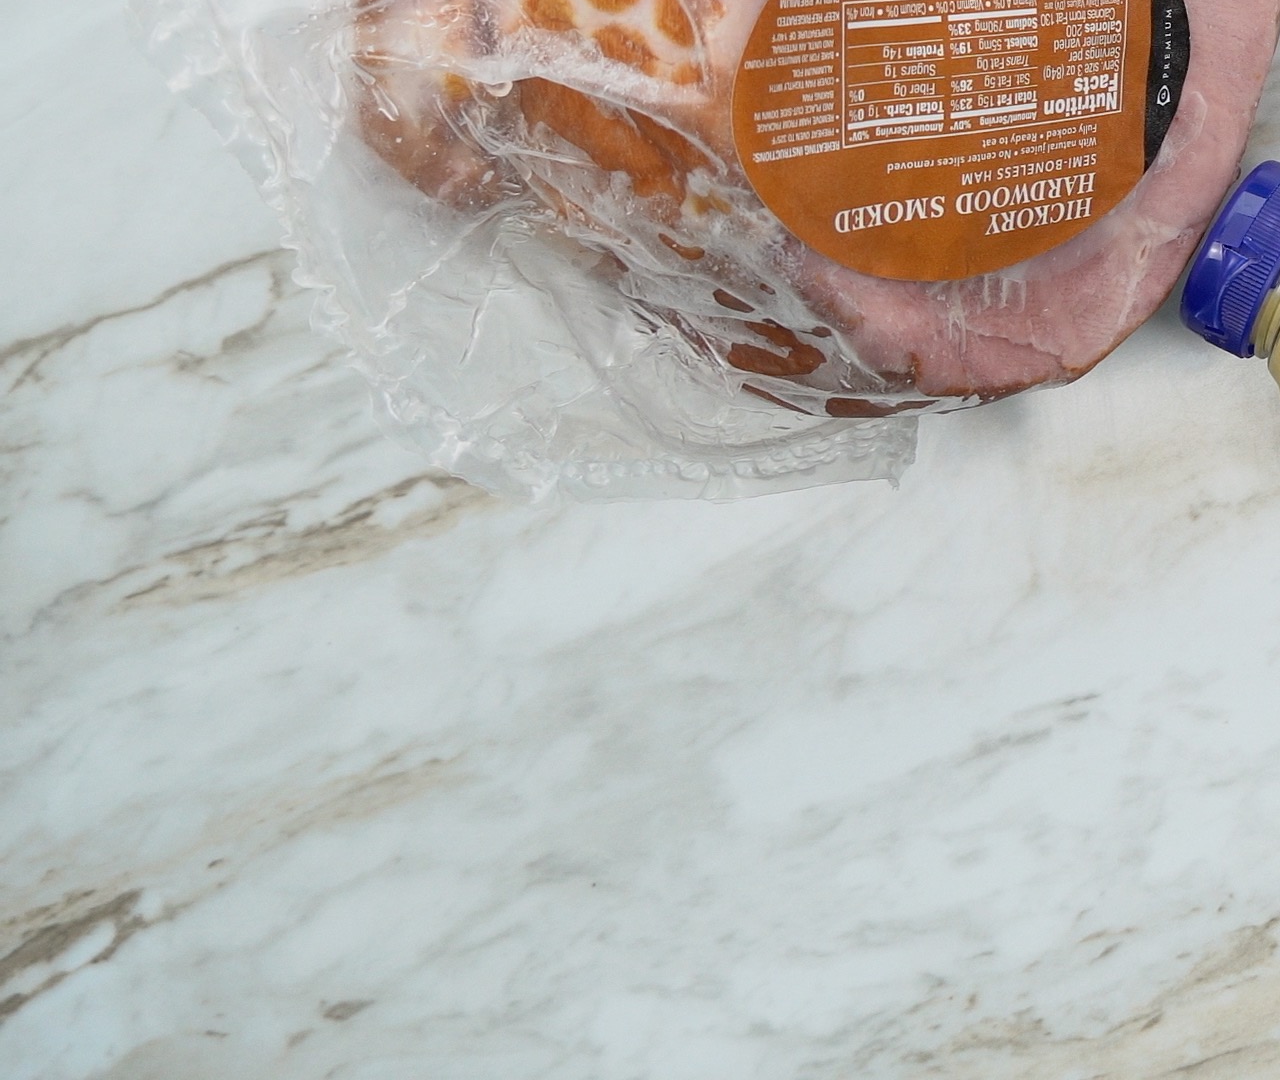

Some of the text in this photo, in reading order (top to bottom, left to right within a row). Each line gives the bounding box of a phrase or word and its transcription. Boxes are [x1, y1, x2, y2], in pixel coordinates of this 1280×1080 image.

[948, 16, 1038, 36] Sodium 790mg 33%
[1066, 20, 1122, 38] Calories 200
[882, 44, 944, 60] Protein 14g
[1162, 8, 1173, 79] PREMIUM
[884, 62, 936, 78] Sugars 1g
[1074, 72, 1118, 94] Facts
[849, 100, 944, 122] Total Carb. 1g 0%
[950, 90, 1037, 111] Total Fat 15g 23%
[1044, 91, 1118, 115] Nutrition
[876, 122, 944, 138] Amount/Serving
[980, 111, 1037, 128] Amount/Serving
[982, 123, 1097, 148] Fully cooked Ready to eat
[887, 137, 1097, 174] With natural juices No center slices removed
[961, 153, 1097, 186] SEMI-BONELESS HAM
[834, 172, 1096, 233] HARDWOOD SMOKED
[985, 197, 1093, 235] HICKORY
